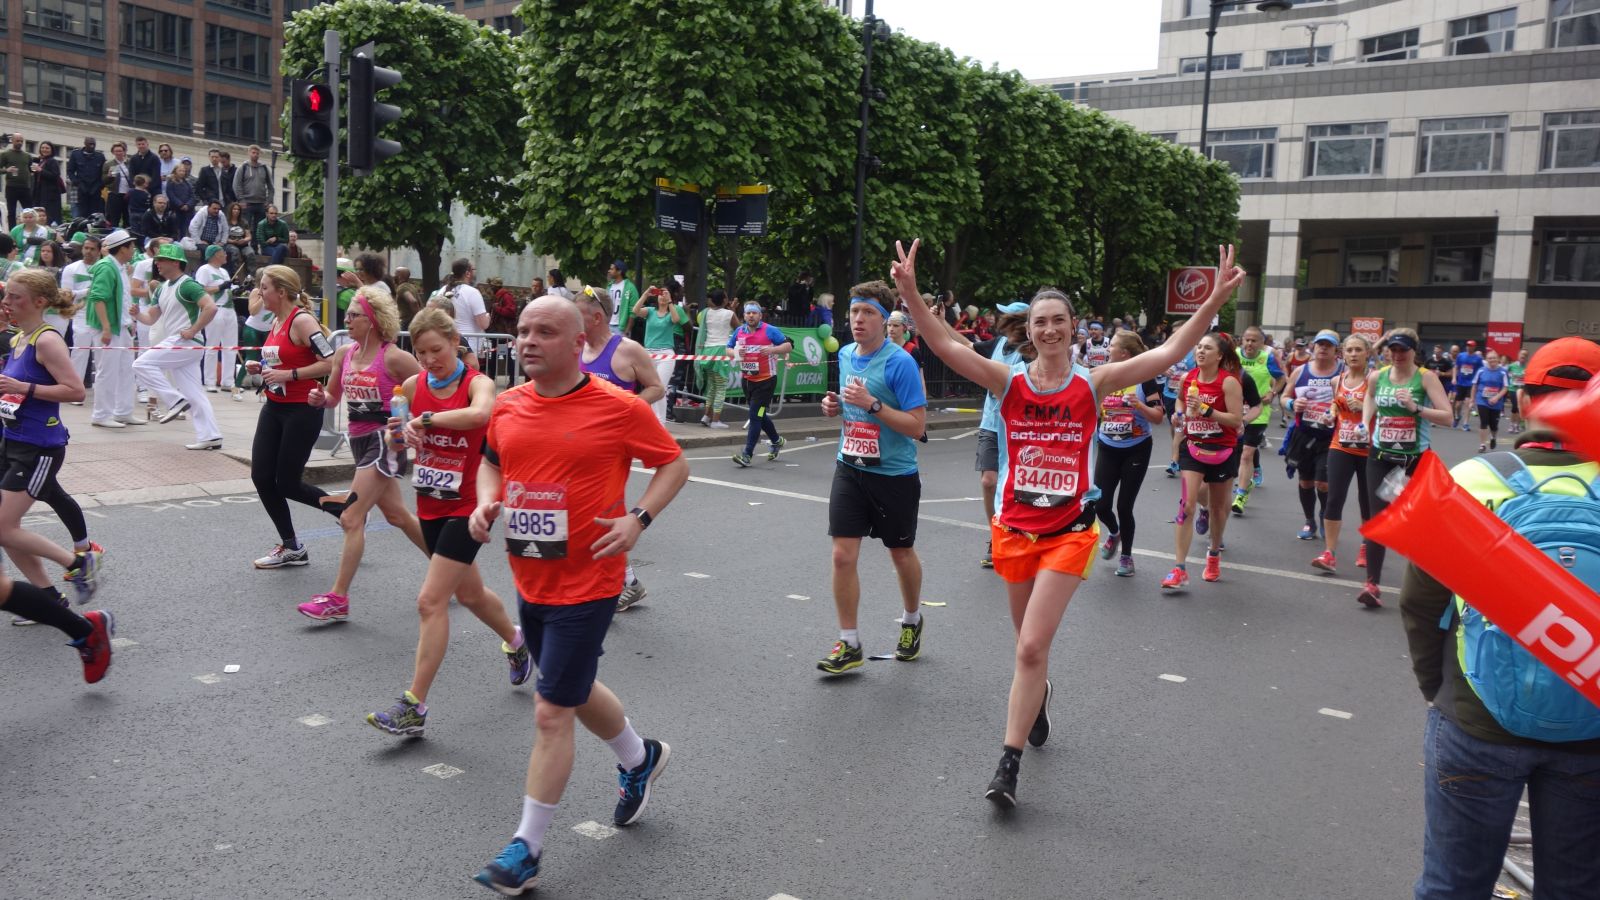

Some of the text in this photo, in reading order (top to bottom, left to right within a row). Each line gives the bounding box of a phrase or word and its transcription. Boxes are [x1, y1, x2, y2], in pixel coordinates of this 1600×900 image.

[1178, 273, 1206, 297] Virgin
[1175, 303, 1201, 311] mone
[796, 372, 822, 386] OXFAM
[1308, 379, 1331, 387] ROBER
[345, 386, 378, 400] 55017
[1379, 386, 1414, 396] LEAE
[1375, 395, 1420, 408] NSPC
[1024, 404, 1072, 421] EMMA
[423, 434, 469, 448] NGELA
[1381, 429, 1414, 440] 45727
[844, 438, 878, 454] 47266
[1045, 454, 1077, 466] money
[417, 467, 454, 488] 9622
[1016, 468, 1075, 491] 34409
[526, 491, 565, 502] money
[508, 511, 556, 536] 4985
